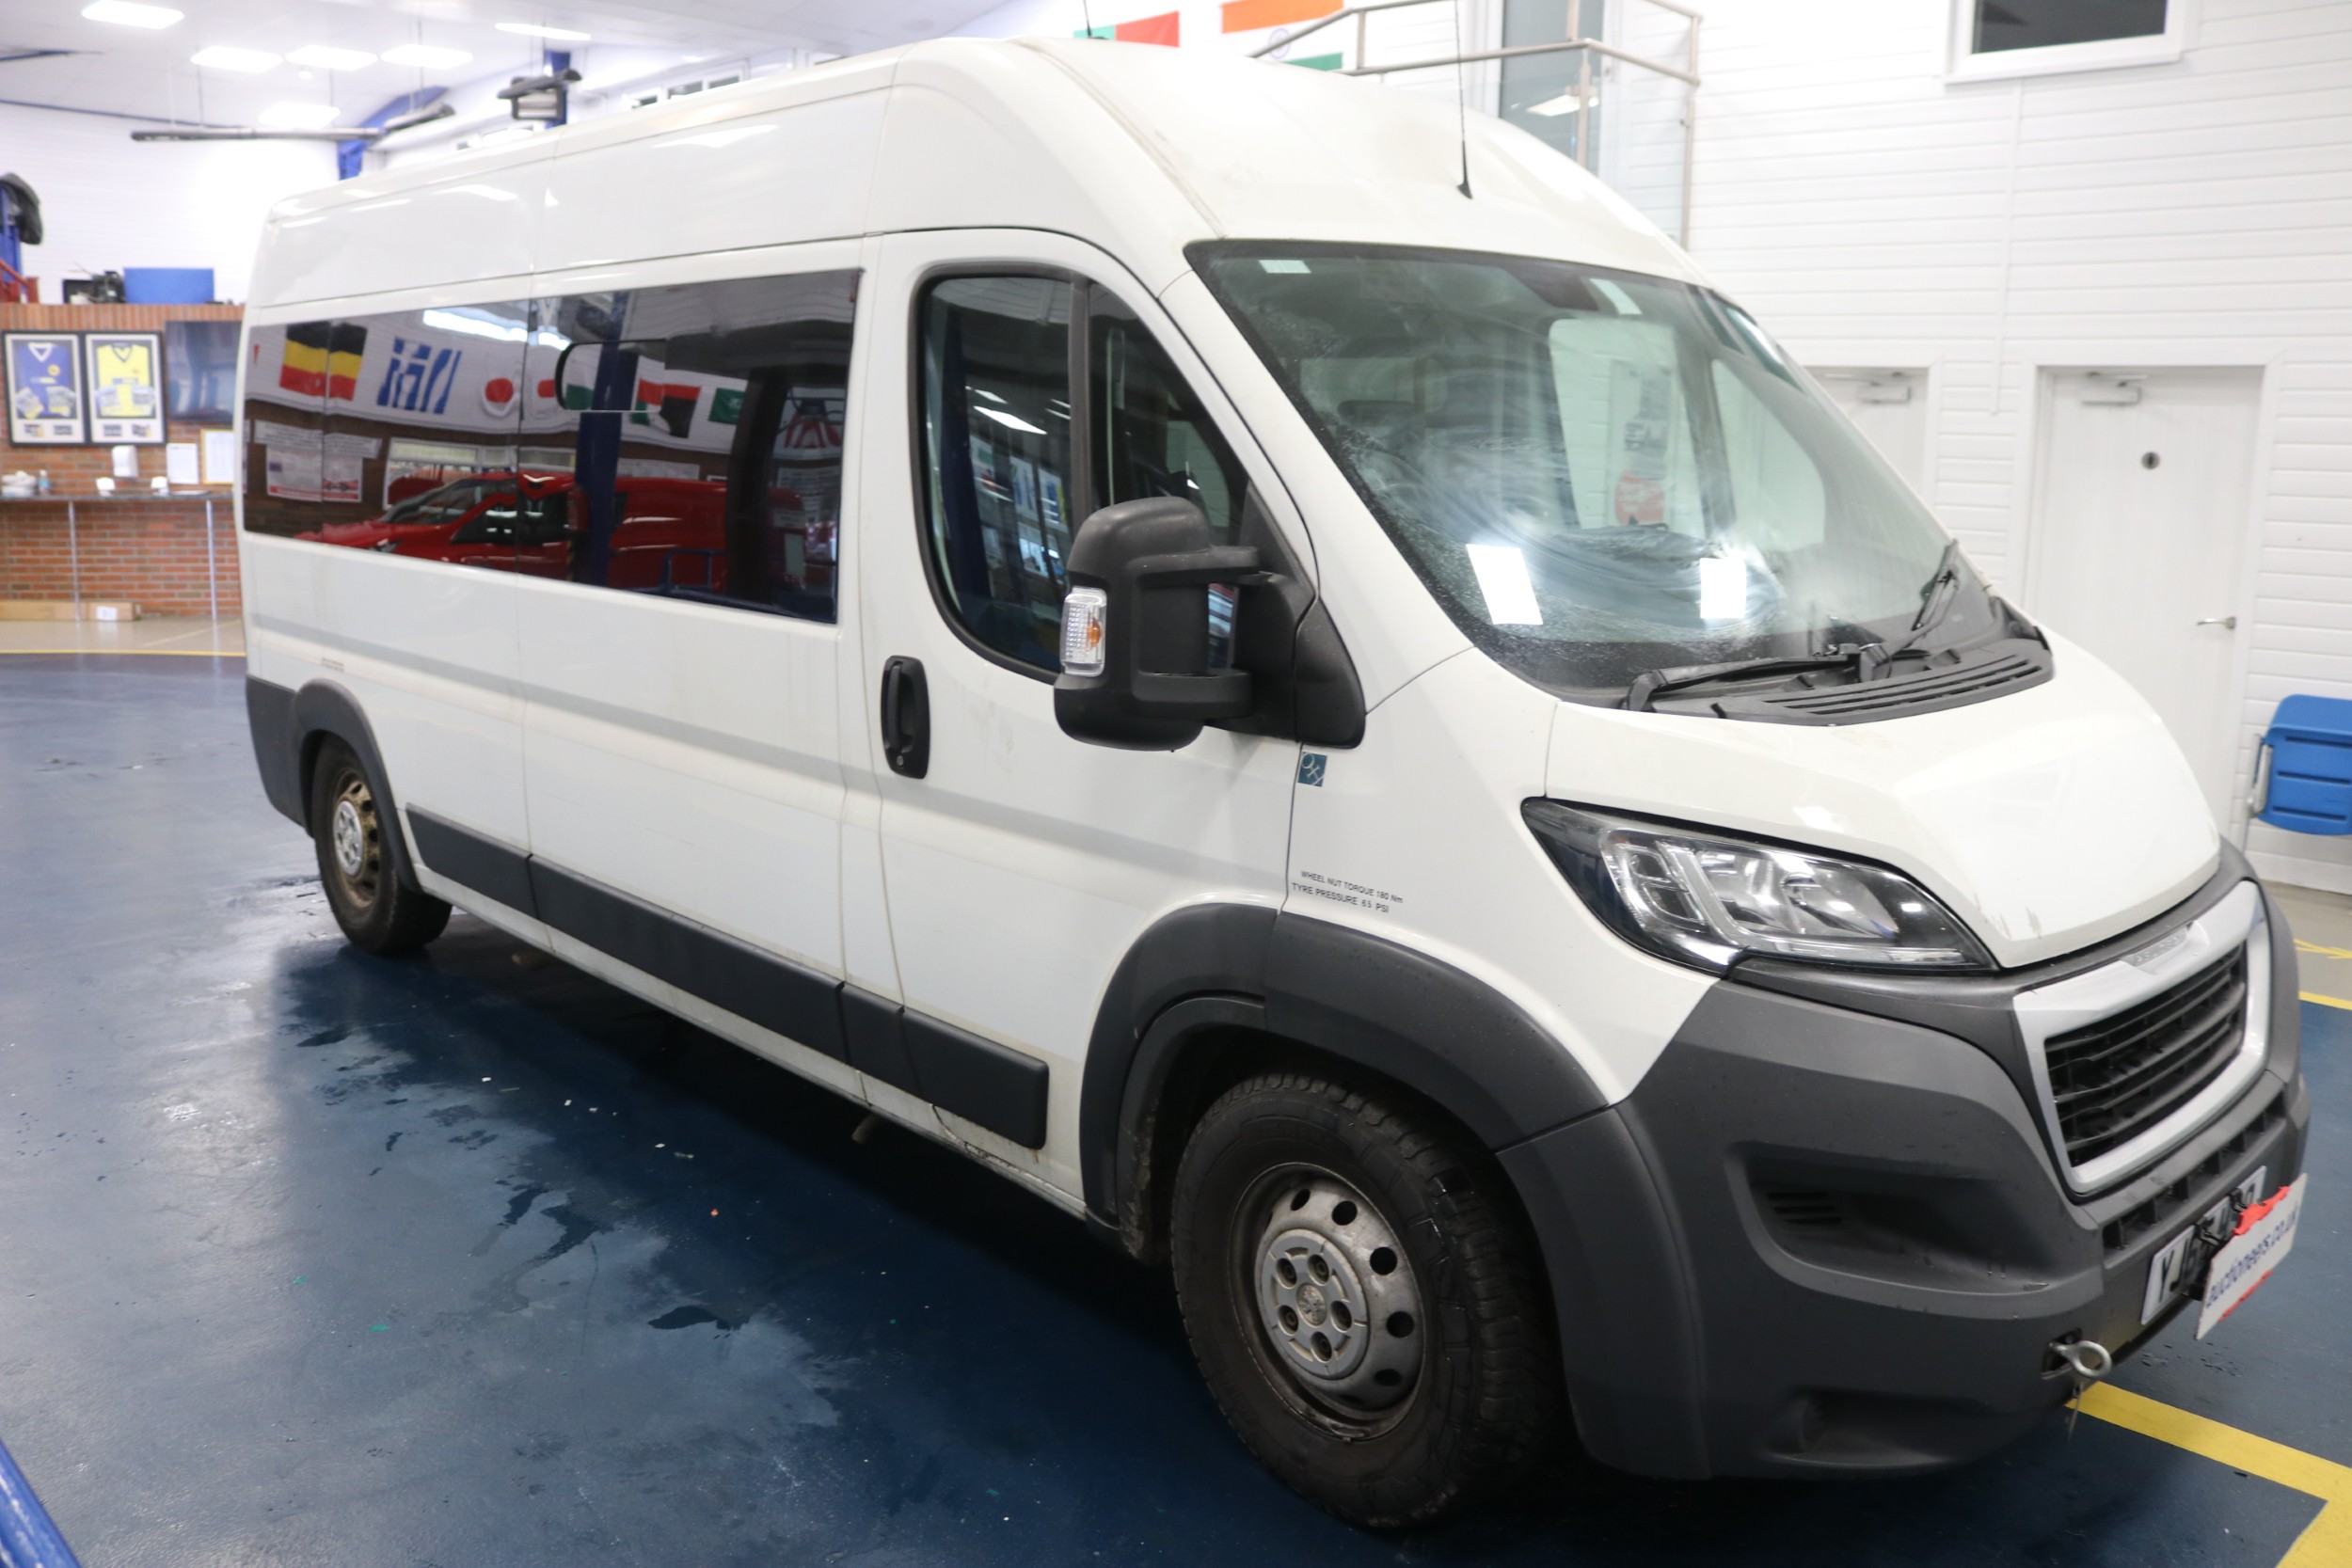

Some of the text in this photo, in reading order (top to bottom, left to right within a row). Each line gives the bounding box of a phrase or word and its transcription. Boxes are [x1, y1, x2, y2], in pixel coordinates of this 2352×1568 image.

[1292, 882, 1314, 895] TYRE
[1315, 888, 1359, 906] PRESSURE
[1375, 902, 1390, 913] PSI
[1301, 870, 1326, 883] WHEEL
[1327, 877, 1343, 888] NUT
[1343, 880, 1375, 896] TORQUE
[1391, 894, 1404, 904] Nm
